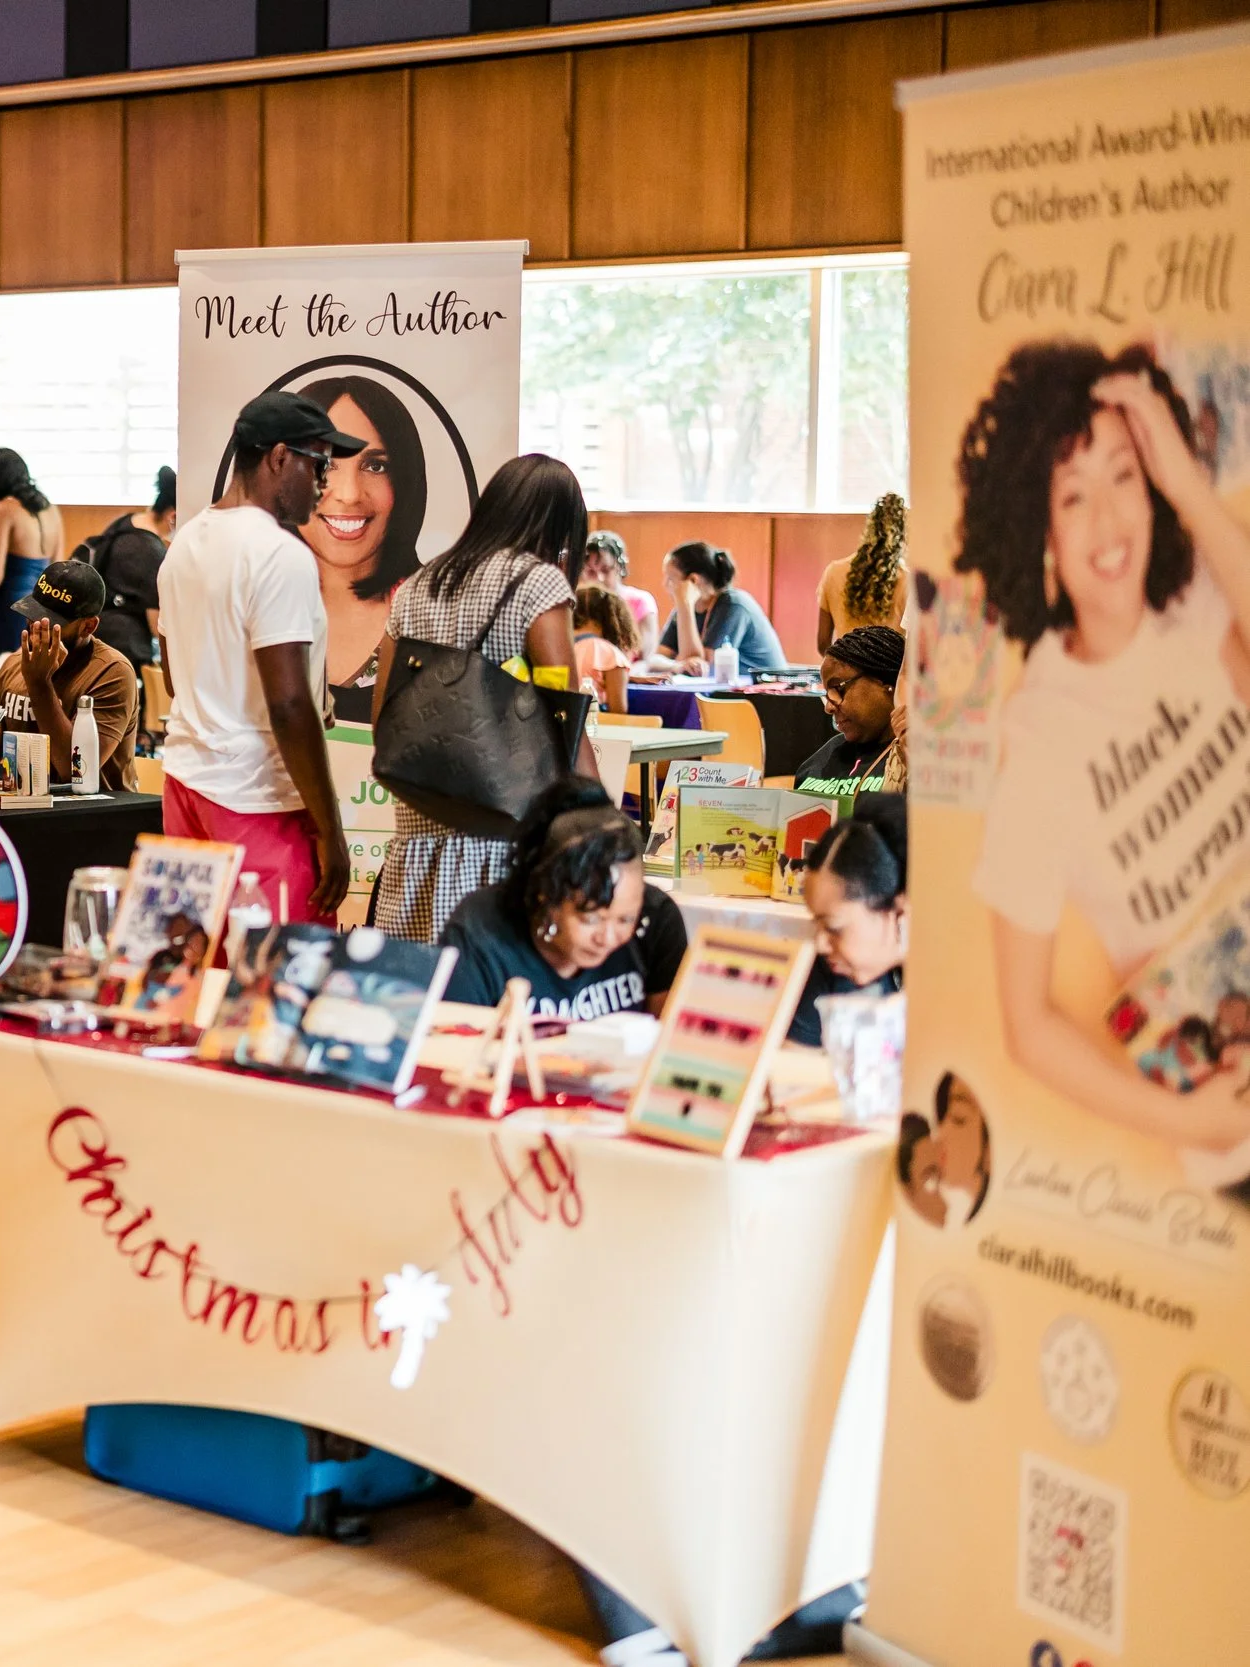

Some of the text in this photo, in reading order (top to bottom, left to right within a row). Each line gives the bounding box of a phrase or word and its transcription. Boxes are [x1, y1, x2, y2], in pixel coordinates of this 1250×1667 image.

[925, 123, 1082, 181] International
[990, 170, 1232, 230] Children's Author
[977, 249, 1080, 324] Ciara
[1145, 232, 1236, 313] Hill
[195, 291, 507, 339] Meet the Author
[37, 573, 73, 604] Capois
[674, 765, 721, 784] 123 Count
[698, 775, 727, 785] with Me
[797, 776, 885, 795] understod
